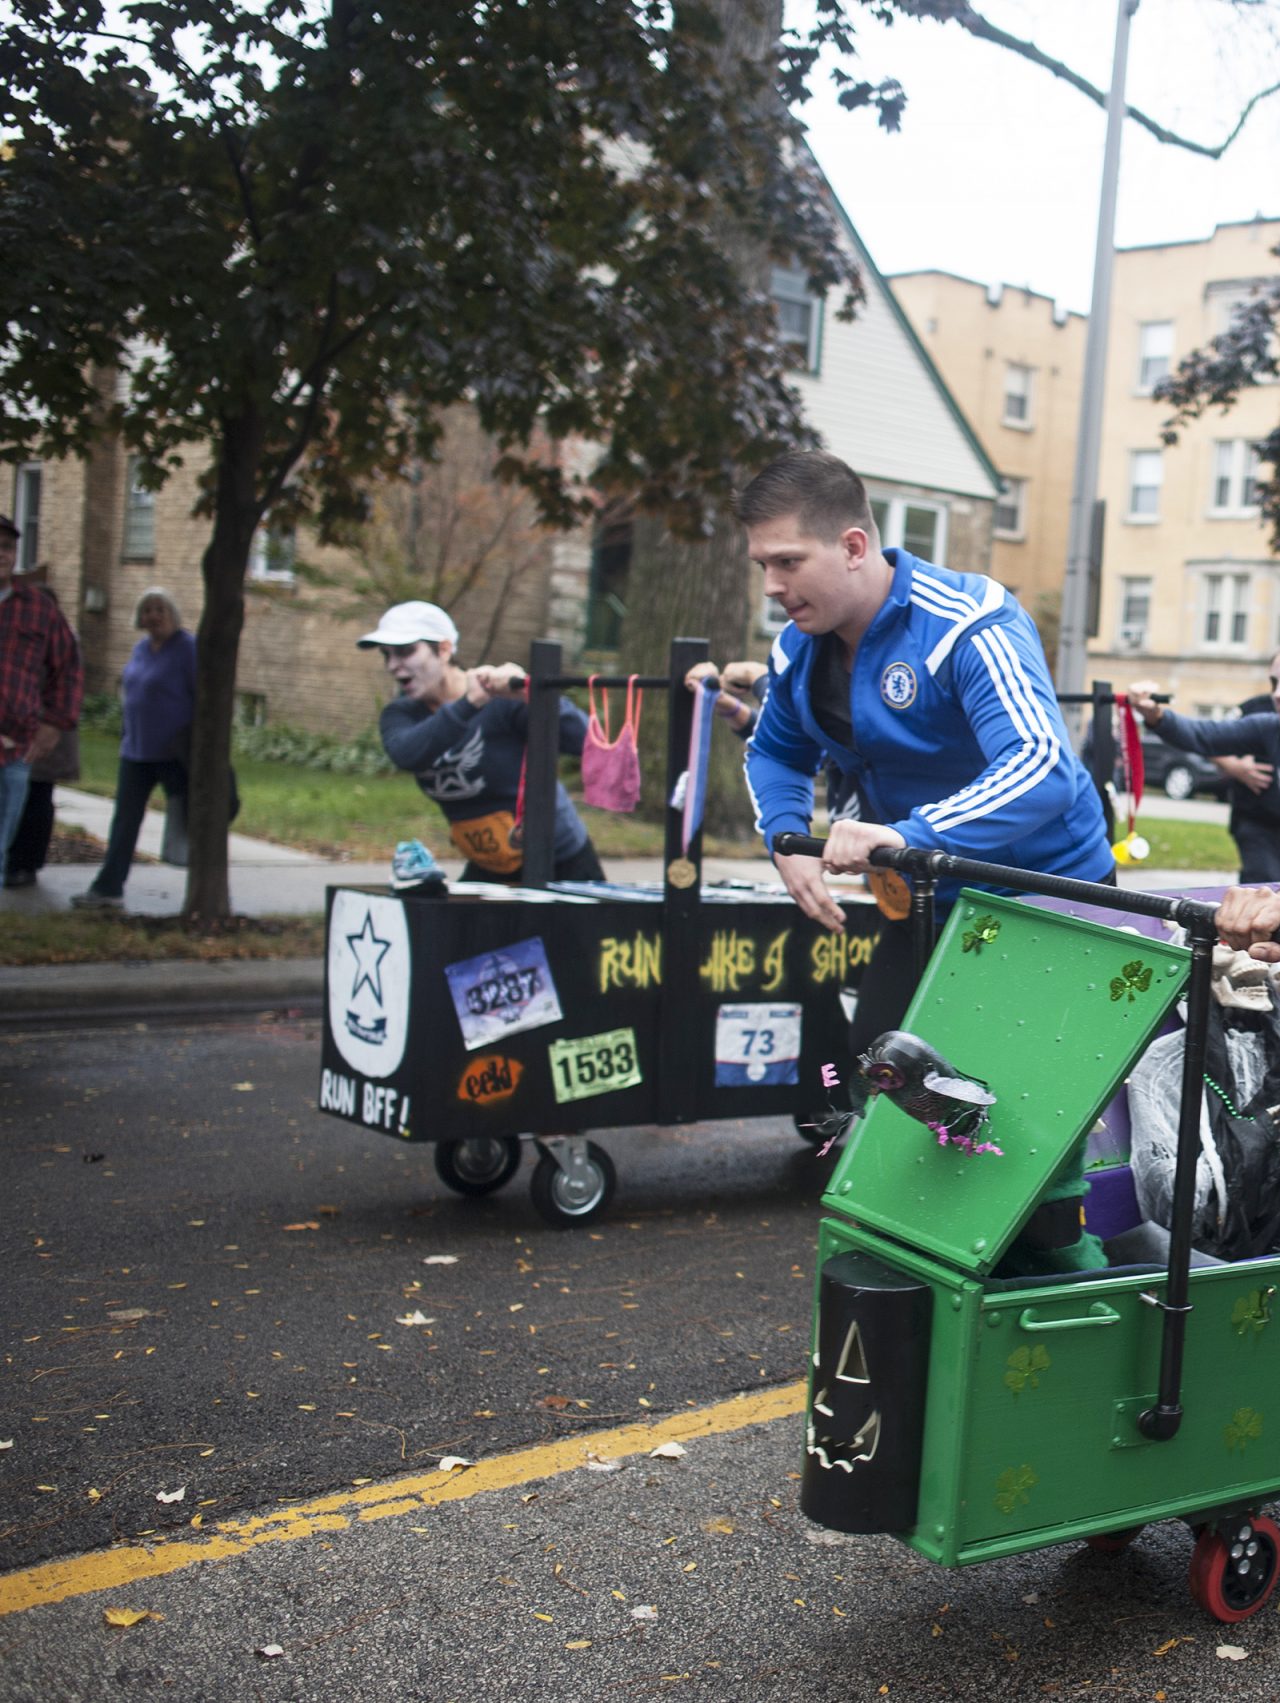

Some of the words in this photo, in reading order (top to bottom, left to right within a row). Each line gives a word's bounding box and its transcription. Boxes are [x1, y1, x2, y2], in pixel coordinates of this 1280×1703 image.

[600, 929, 662, 993] RUN
[761, 928, 792, 991] A
[465, 967, 538, 1016] 3287
[556, 1043, 634, 1089] 1533
[741, 1029, 775, 1057] 73
[320, 1068, 356, 1116] RUN
